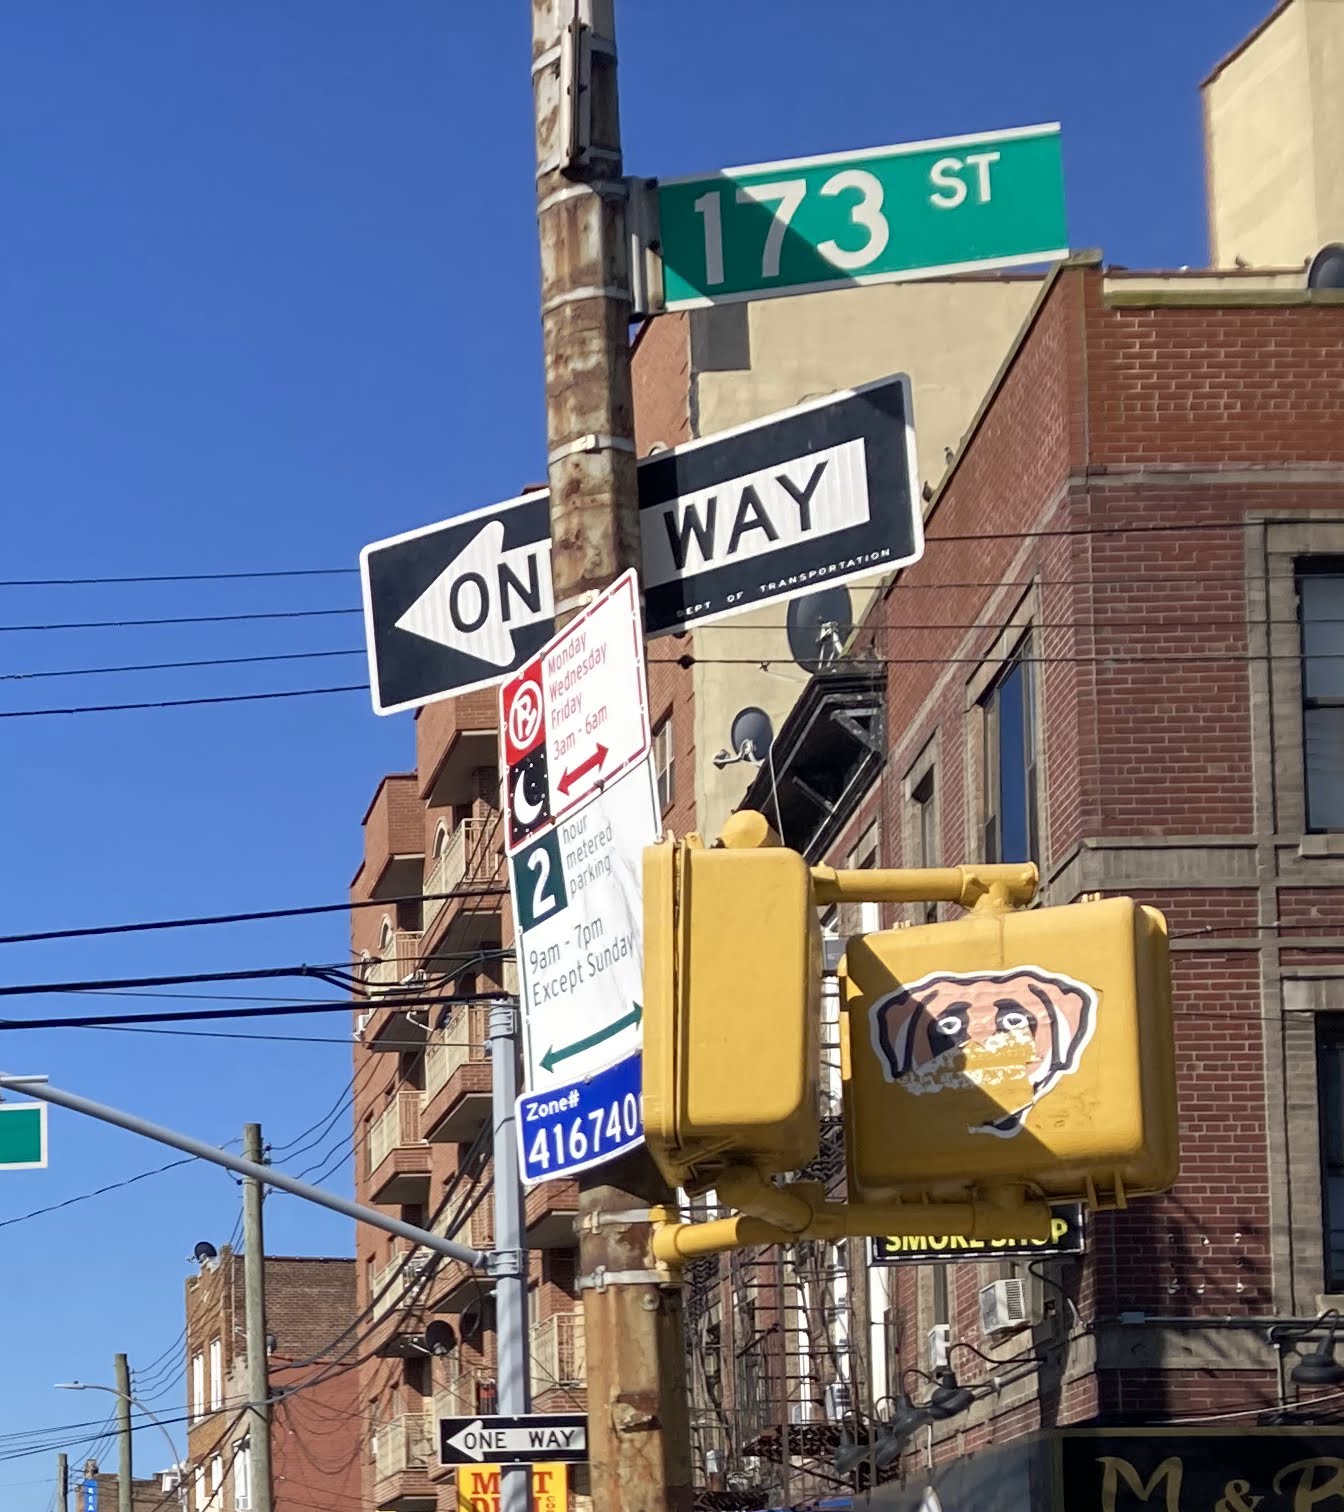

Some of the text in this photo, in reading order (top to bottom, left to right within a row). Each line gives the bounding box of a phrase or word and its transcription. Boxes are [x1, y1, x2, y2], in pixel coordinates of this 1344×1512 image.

[694, 151, 1001, 286] 173 ST
[448, 459, 829, 635] ON WAY
[676, 547, 892, 618] DEPT OF TRANSPORTATION
[547, 630, 587, 677] Monday
[548, 643, 608, 702] Wednesday
[550, 691, 584, 730] Friday
[552, 731, 577, 760] 3am
[584, 704, 609, 736] 6am
[561, 813, 589, 843] hour
[565, 822, 613, 871] metered
[527, 846, 557, 919] 2
[568, 852, 613, 899] parking
[528, 940, 561, 976] 9am
[573, 915, 605, 948] 7pm
[532, 931, 635, 1008] Except Sunday
[525, 1089, 580, 1122] Zone#
[528, 1092, 643, 1169] 416740
[464, 1430, 576, 1449] ONE WAY
[470, 1471, 553, 1495] MT
